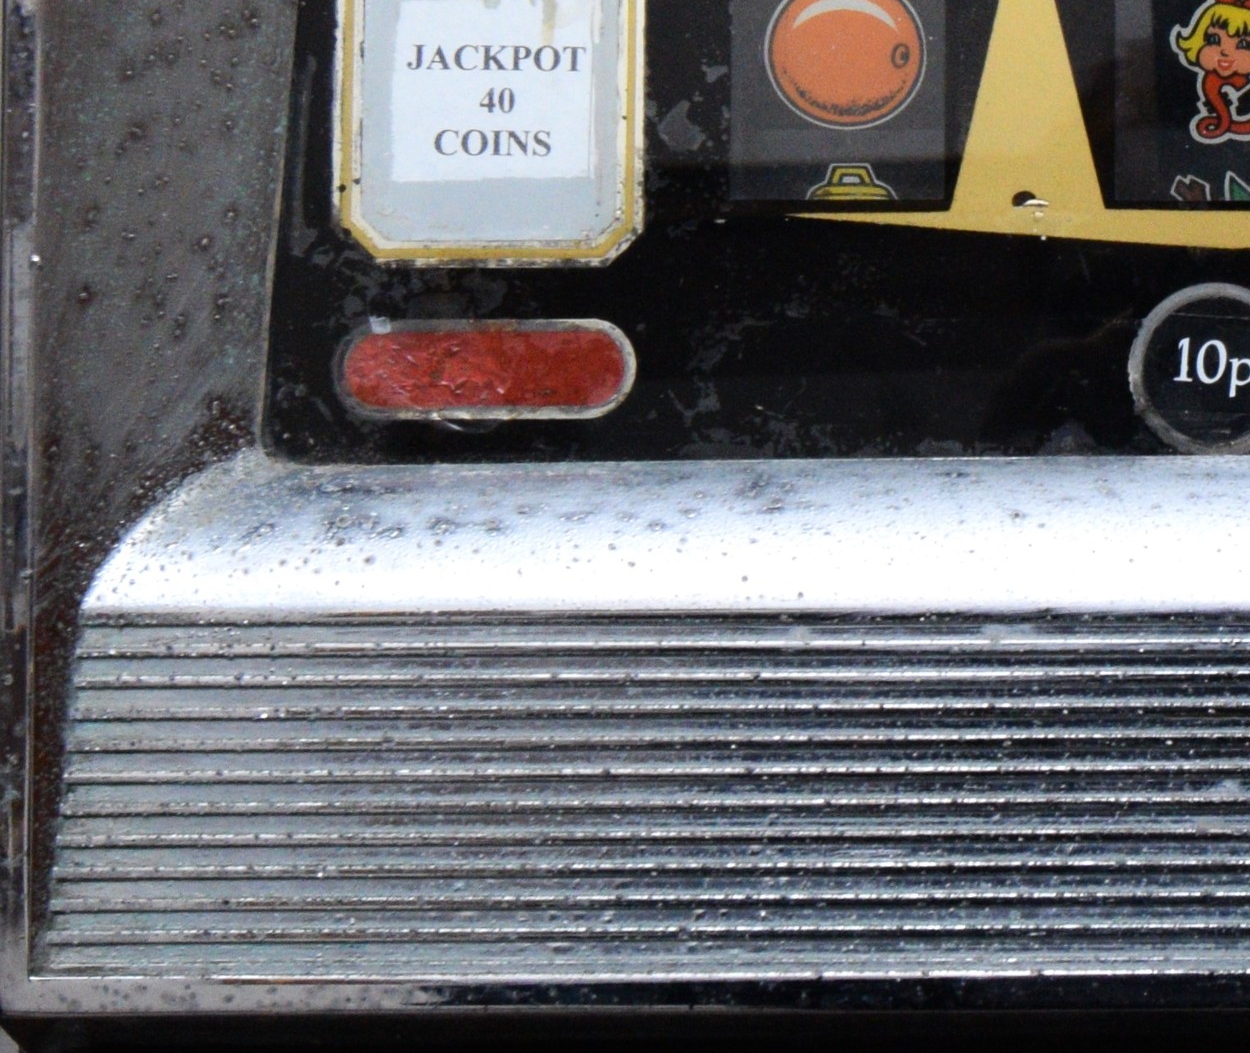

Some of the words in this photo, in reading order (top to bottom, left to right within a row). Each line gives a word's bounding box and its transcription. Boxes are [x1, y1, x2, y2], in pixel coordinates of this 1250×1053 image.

[406, 44, 586, 72] JACKPOT
[479, 87, 515, 114] 40
[433, 129, 552, 158] COINS
